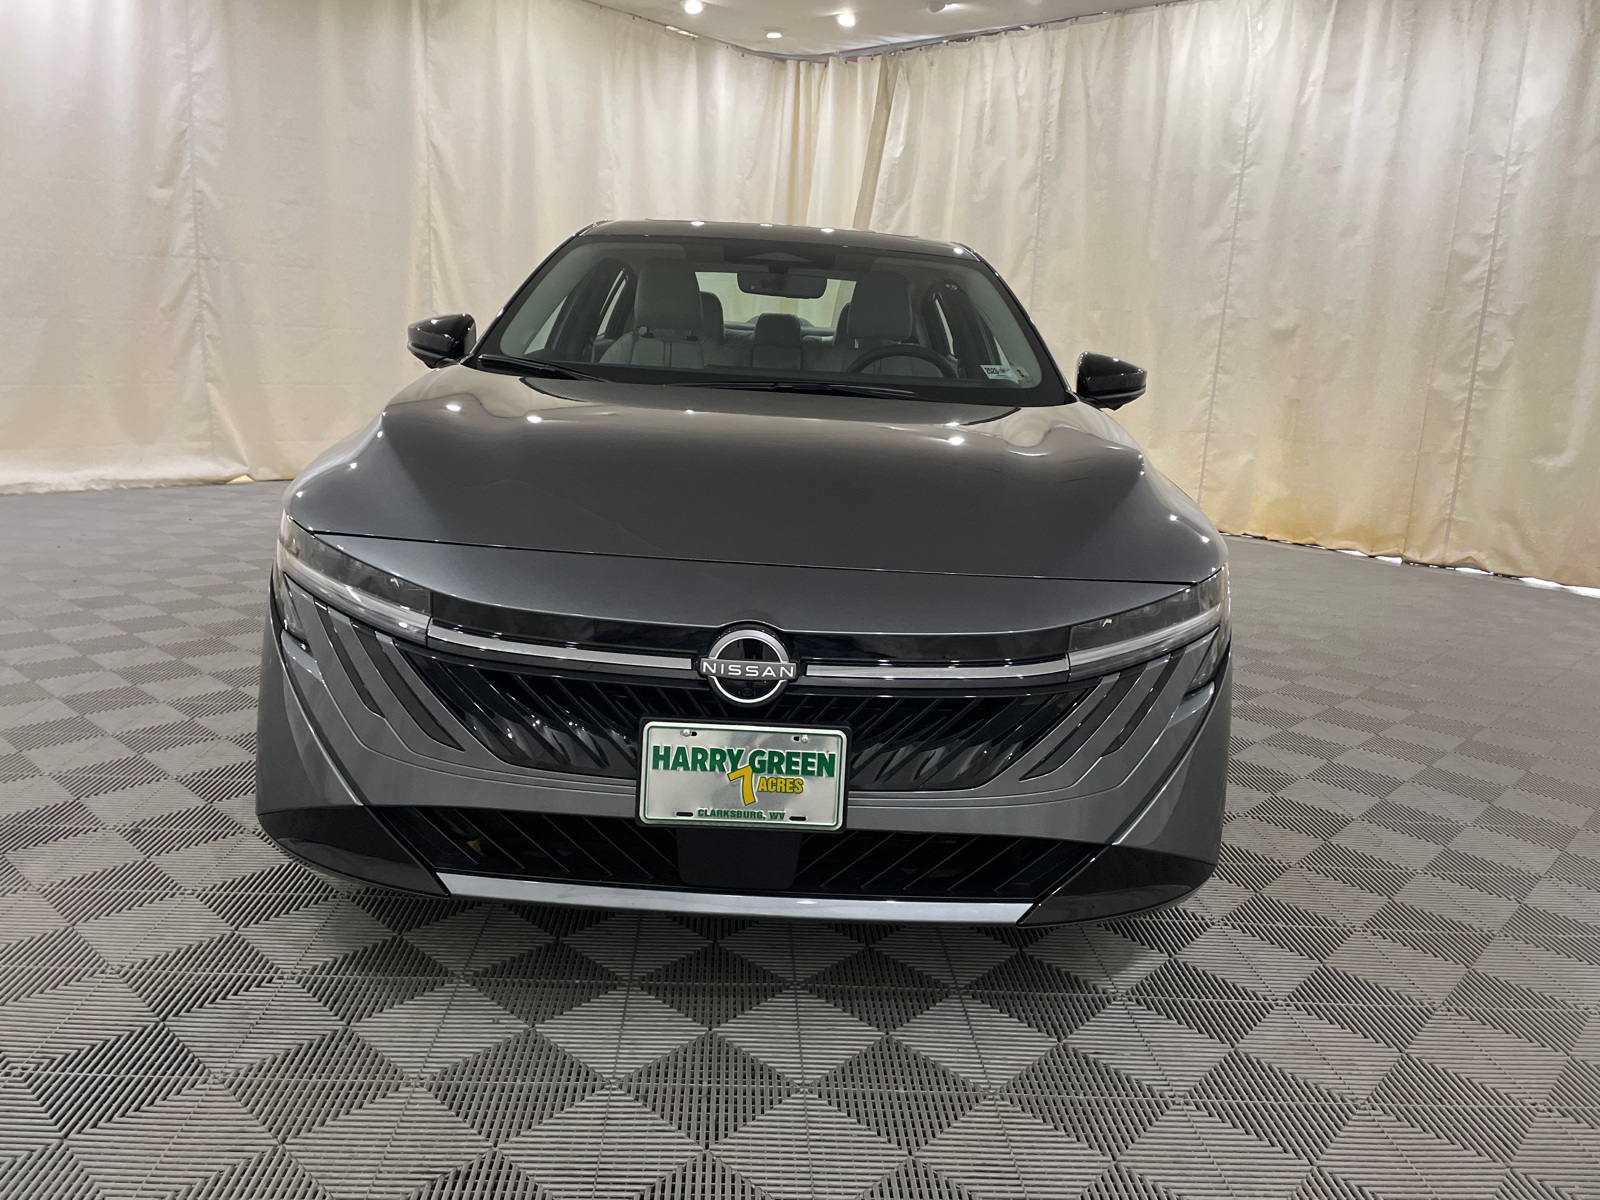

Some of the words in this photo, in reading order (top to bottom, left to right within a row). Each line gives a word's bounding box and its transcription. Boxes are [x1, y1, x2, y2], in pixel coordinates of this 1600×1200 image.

[702, 661, 795, 678] NISSAN
[652, 745, 745, 773] HARRY
[749, 749, 836, 777] GREEN
[727, 765, 756, 806] 7
[758, 777, 804, 793] ACRES
[697, 808, 766, 820] CLARKSBURG,
[769, 812, 786, 820] WV
